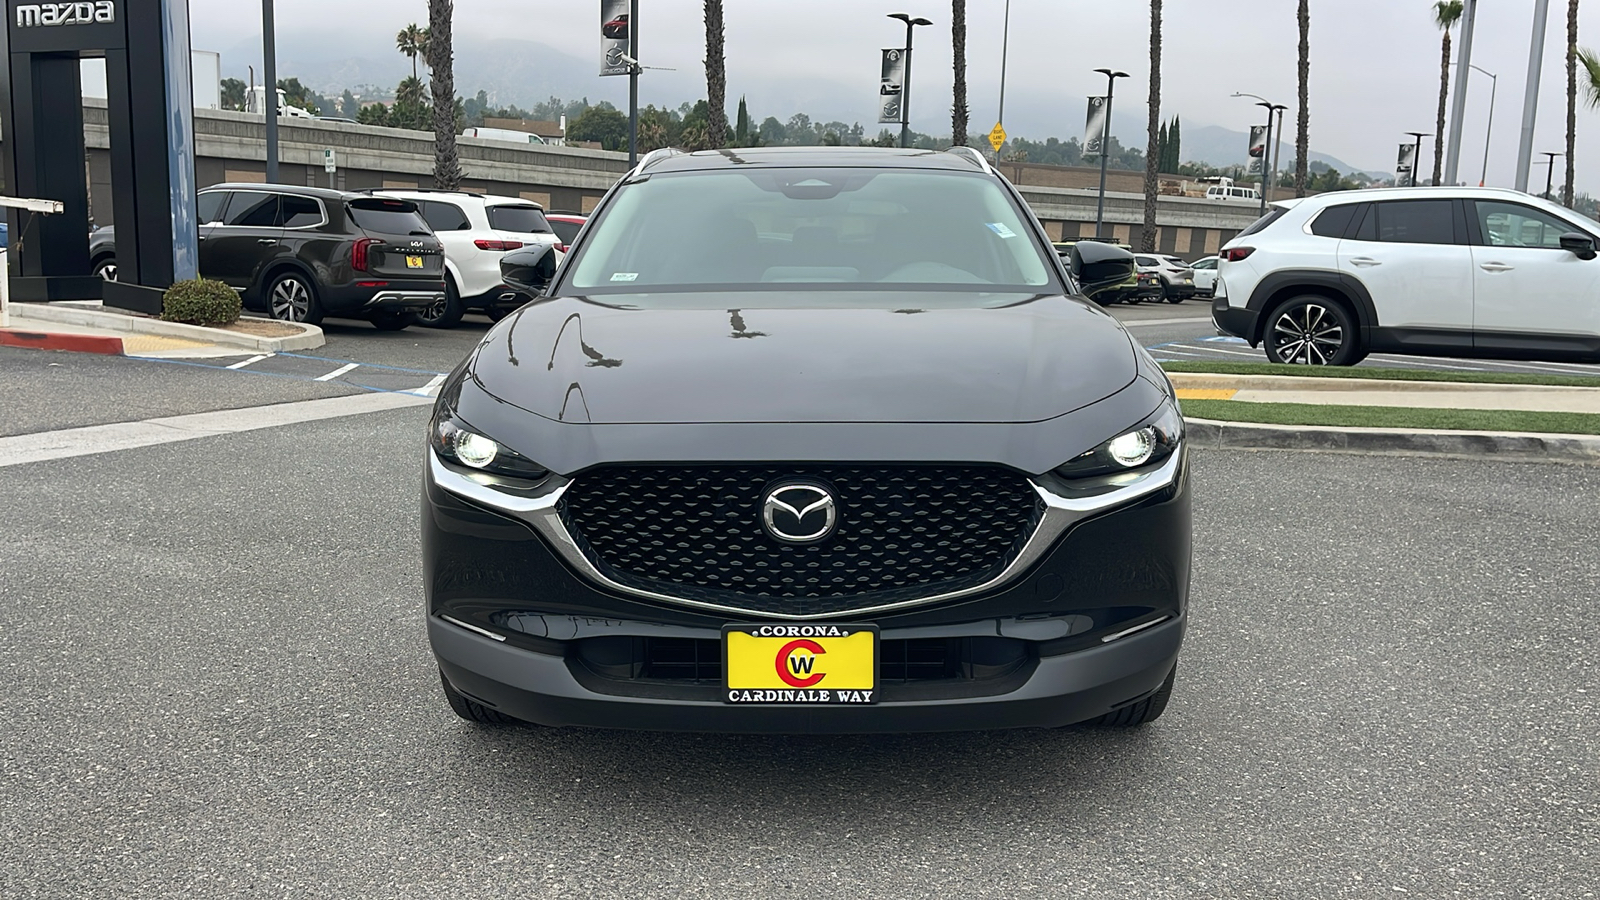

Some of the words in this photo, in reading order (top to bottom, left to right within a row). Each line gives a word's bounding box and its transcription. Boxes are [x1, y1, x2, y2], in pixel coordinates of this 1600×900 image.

[759, 625, 842, 637] CORONA
[728, 690, 831, 702] CARDINALE
[836, 690, 874, 703] WAY
